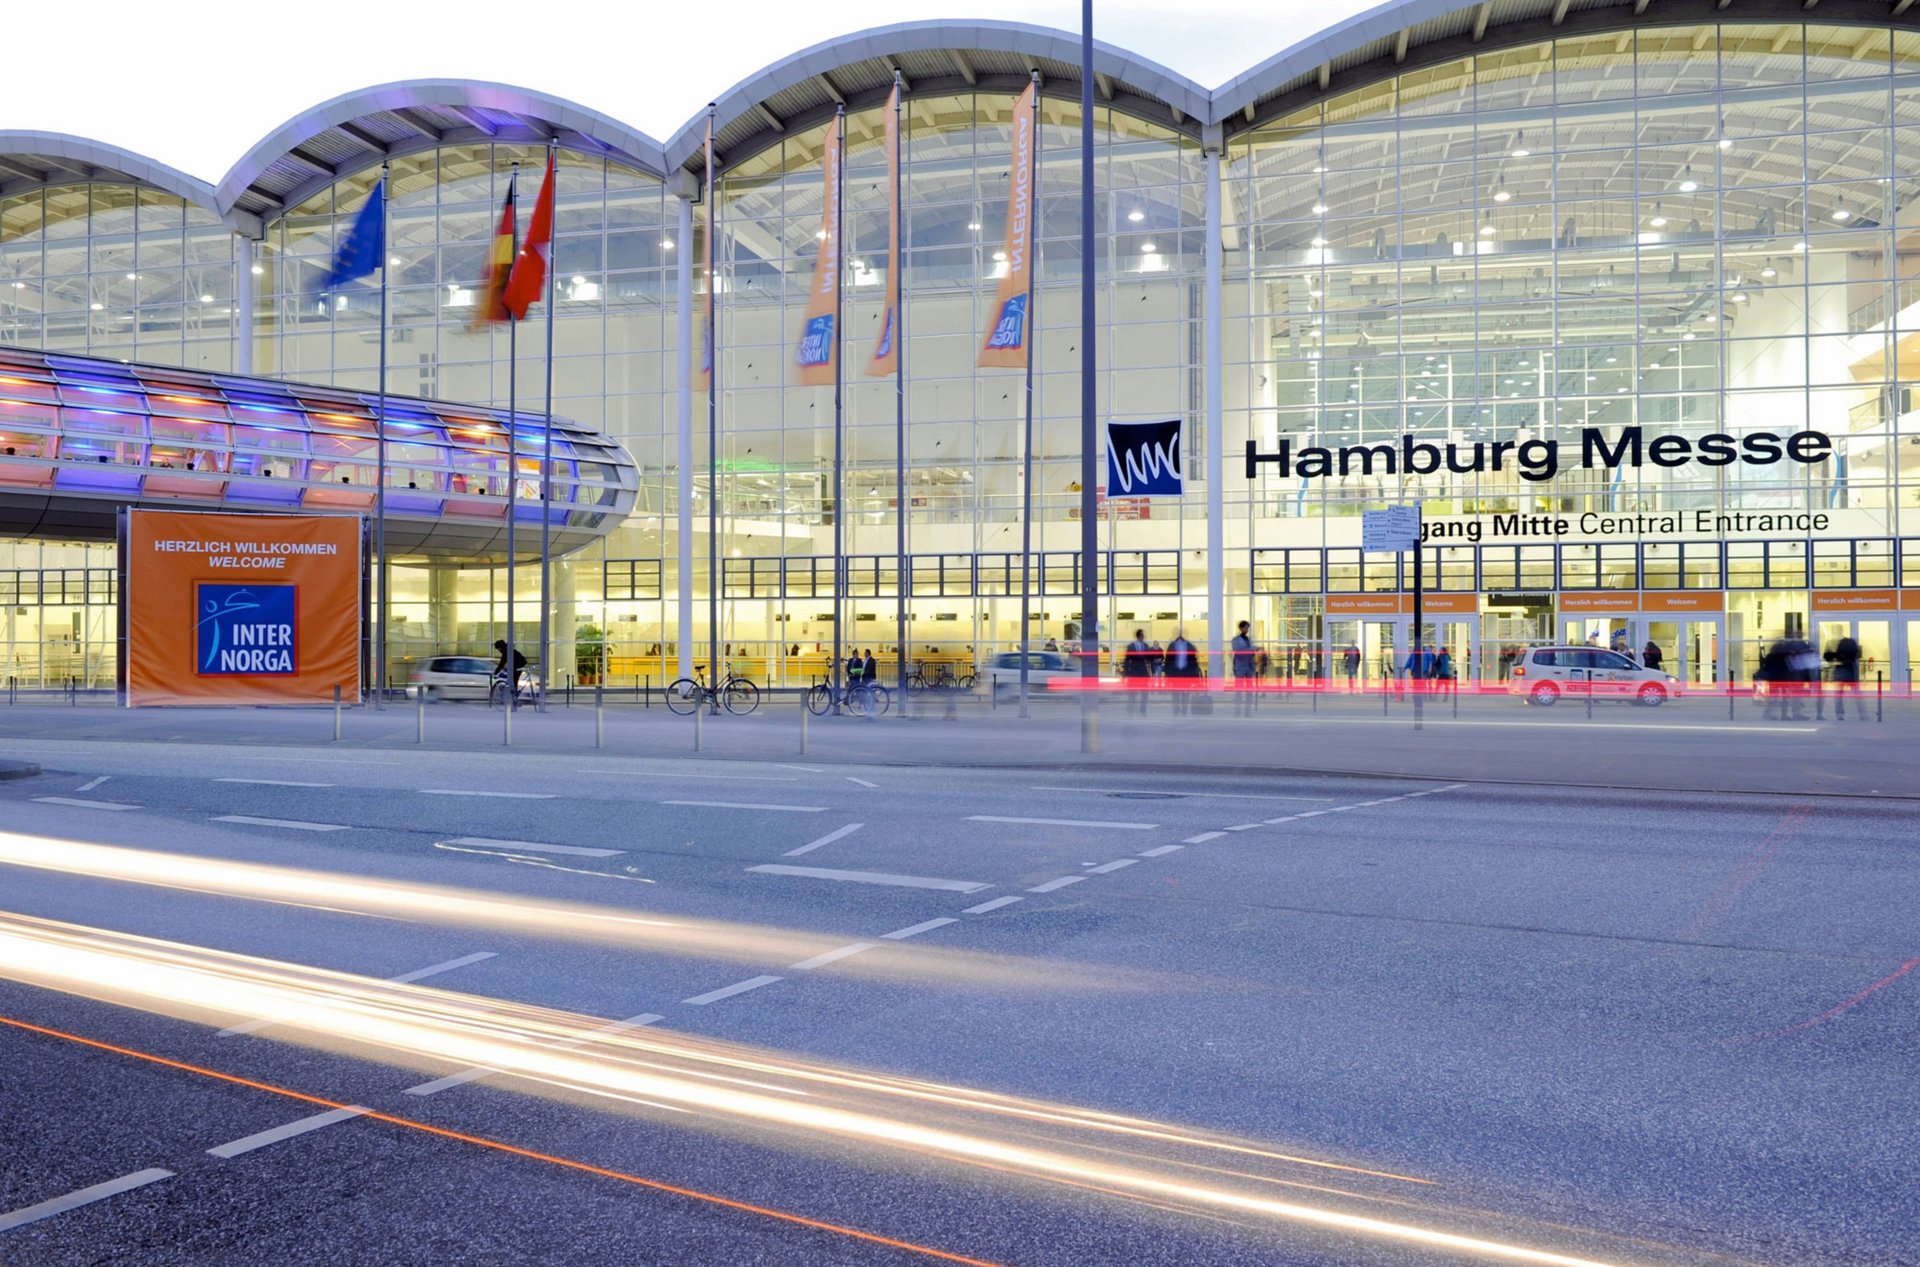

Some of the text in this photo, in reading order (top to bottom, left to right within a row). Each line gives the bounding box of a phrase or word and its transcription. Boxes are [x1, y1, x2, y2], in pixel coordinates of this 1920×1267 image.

[1245, 426, 1832, 482] Hamburg Messe
[1493, 514, 1569, 536] Mitte
[1580, 510, 1683, 535] Central
[1696, 510, 1829, 533] Entrance
[154, 540, 337, 555] HERZLICH WILLKOMMEN
[209, 556, 286, 568] WELCOME
[233, 624, 292, 645] INTER
[220, 649, 293, 671] NORGA
